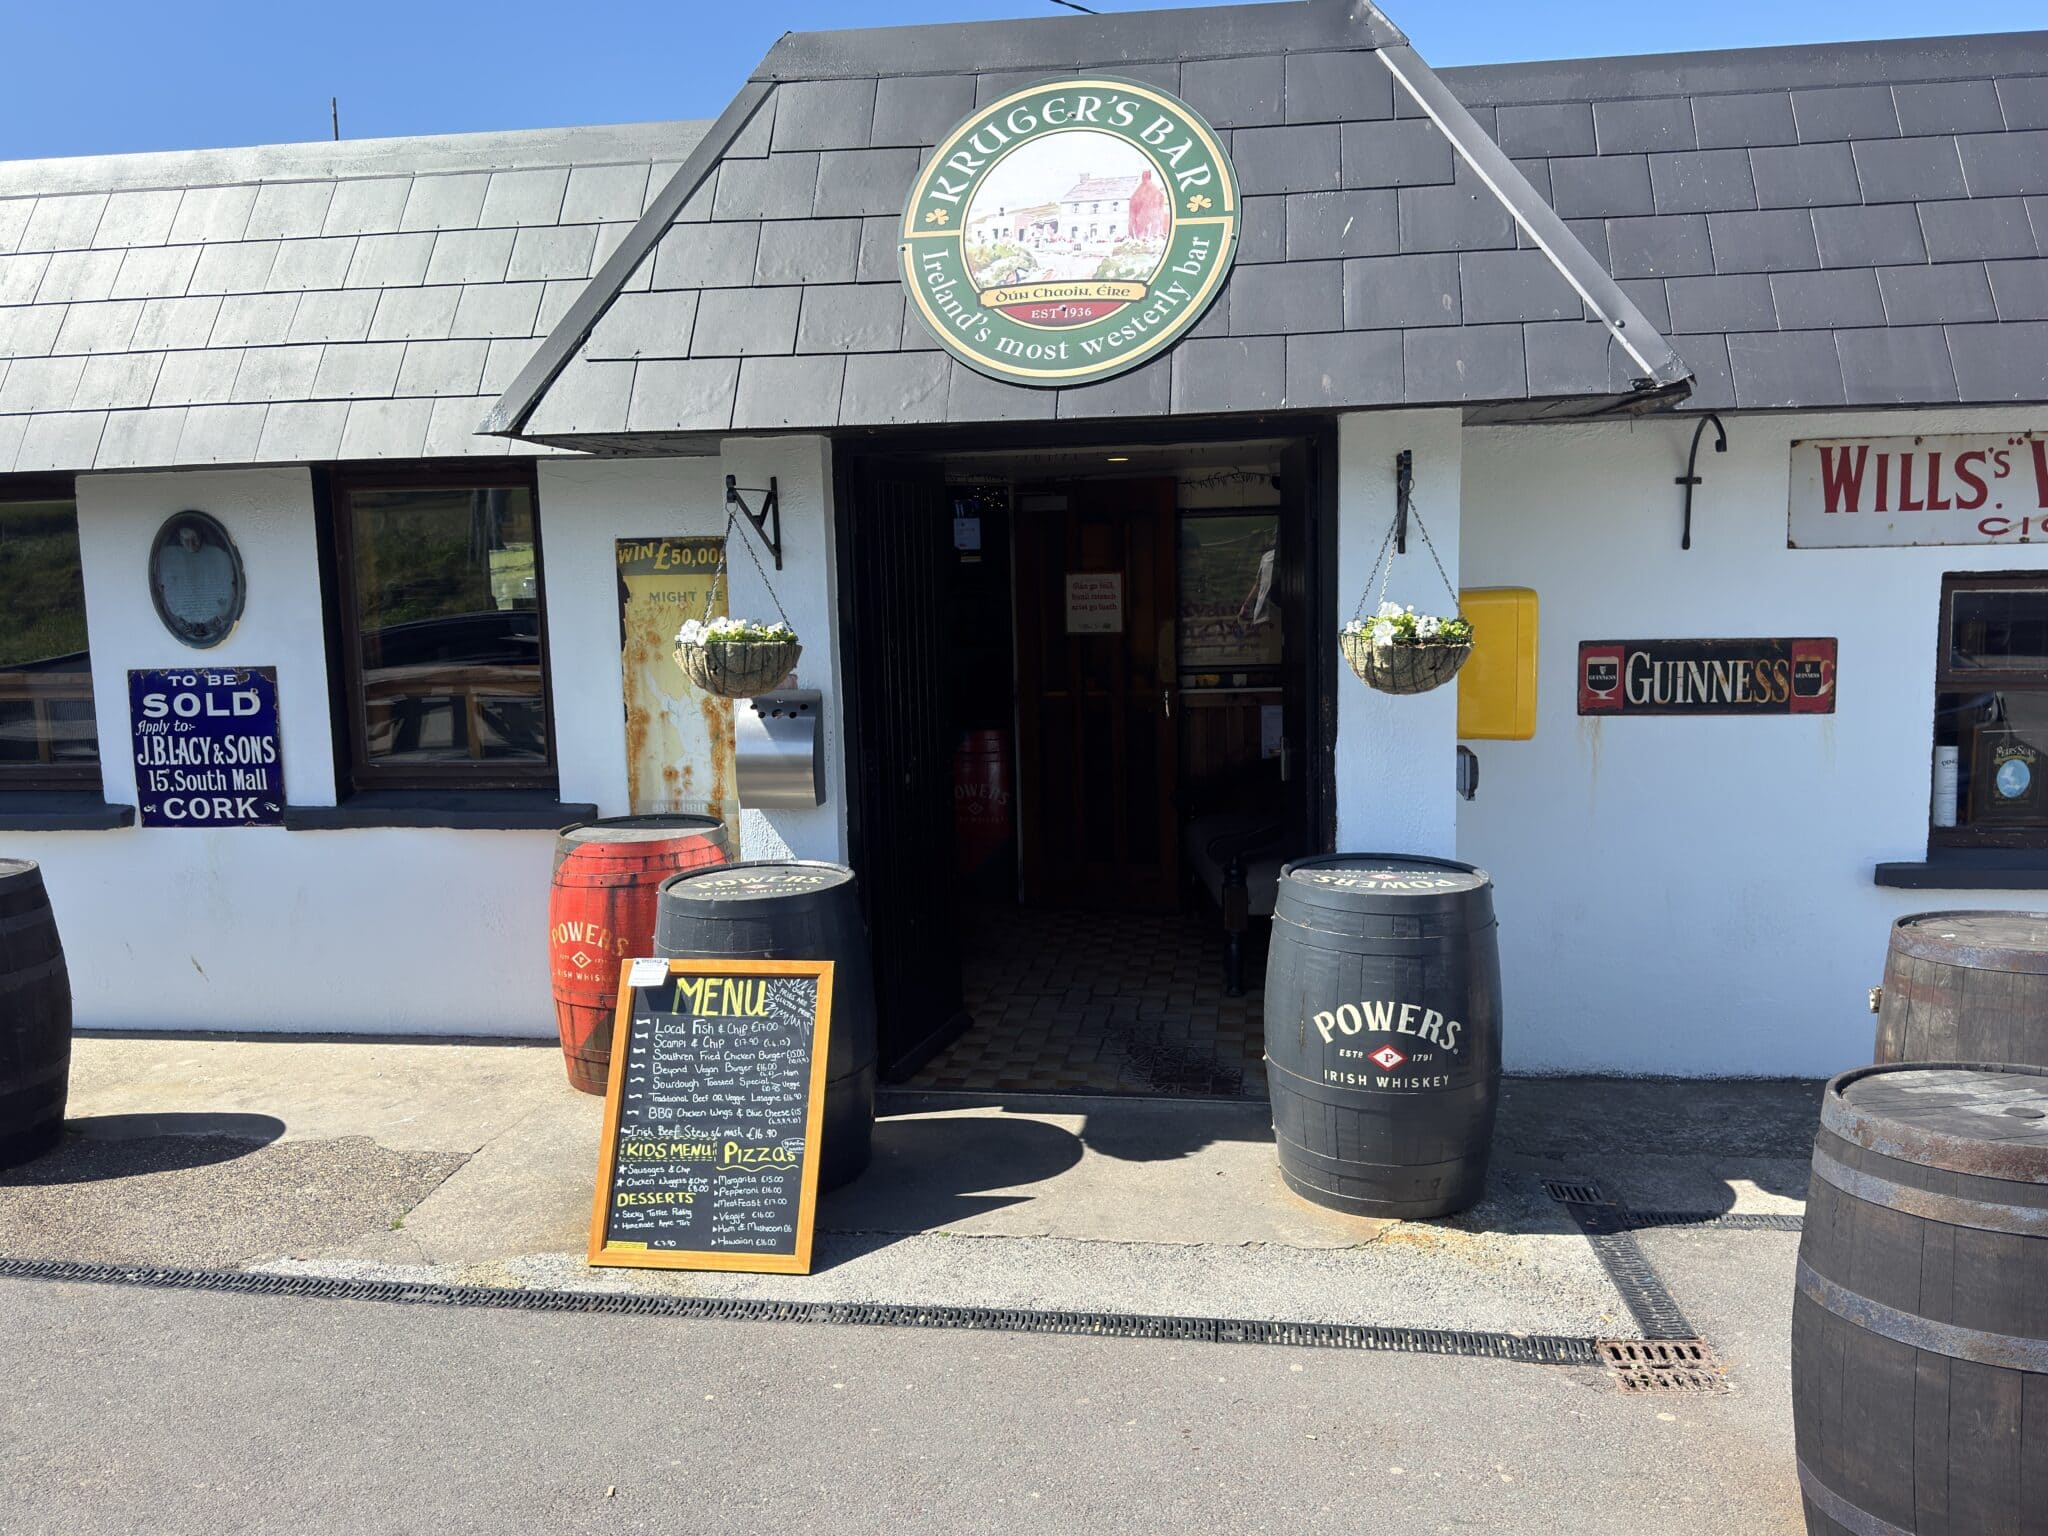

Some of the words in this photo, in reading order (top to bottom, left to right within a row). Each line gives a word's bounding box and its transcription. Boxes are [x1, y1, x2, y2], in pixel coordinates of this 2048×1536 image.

[928, 95, 1141, 206] KRUGER'S
[1140, 115, 1212, 192] BAR
[922, 248, 992, 343] Ireland's
[994, 335, 1070, 360] most
[1080, 282, 1192, 357] westerly
[1172, 236, 1211, 277] bar
[1031, 309, 1057, 319] EST
[1063, 307, 1092, 319] 1936
[619, 544, 653, 564] WIN
[650, 592, 698, 602] MIGHT
[167, 675, 197, 686] TO
[207, 674, 237, 686] BE
[1625, 650, 1790, 705] GUINNESS
[142, 691, 261, 718] SOLD
[136, 720, 170, 735] Apply
[174, 769, 227, 792] South
[233, 769, 268, 791] Mall
[163, 797, 260, 819] CORK
[694, 876, 825, 889] POWERS
[1313, 875, 1459, 889] POWERS
[552, 921, 629, 956] POWERS
[672, 977, 768, 1017] MENU
[654, 1018, 686, 1034] Local
[692, 1019, 714, 1034] Fish
[727, 1023, 748, 1036] Chip
[1313, 1001, 1462, 1050] POWERS
[653, 1034, 685, 1048] Scampi
[690, 1037, 698, 1047] &
[702, 1036, 725, 1048] Chip
[700, 1050, 720, 1060] Fried
[723, 1050, 756, 1060] Chicken
[758, 1050, 786, 1062] Burger
[1412, 1053, 1433, 1062] 1791
[652, 1062, 687, 1077] Beyond
[694, 1064, 719, 1076] Vegan
[724, 1062, 752, 1074] Burger
[652, 1076, 699, 1092] Sourdough
[703, 1077, 733, 1087] Toasted
[739, 1077, 769, 1088] Special
[1324, 1070, 1367, 1086] IRISH
[1376, 1074, 1449, 1089] WHISKEY
[648, 1092, 688, 1102] Traditional
[692, 1094, 709, 1102] Beef
[751, 1092, 782, 1105] Lasagne
[648, 1107, 673, 1119] BBQ
[676, 1108, 707, 1117] Chicken
[710, 1108, 733, 1119] Wings
[746, 1108, 763, 1117] Blue
[765, 1108, 790, 1118] Cheese
[630, 1125, 653, 1138] Irish
[657, 1125, 681, 1139] Beef
[684, 1125, 709, 1138] Stew
[627, 1143, 667, 1158] KIDS
[670, 1143, 712, 1157] MENU
[724, 1141, 796, 1164] Pizzas
[627, 1163, 665, 1177] Sausages
[626, 1178, 655, 1186] Chicken
[719, 1186, 759, 1197] Pepperoni
[617, 1192, 696, 1207] DESSERTS
[719, 1212, 746, 1224] Veggie
